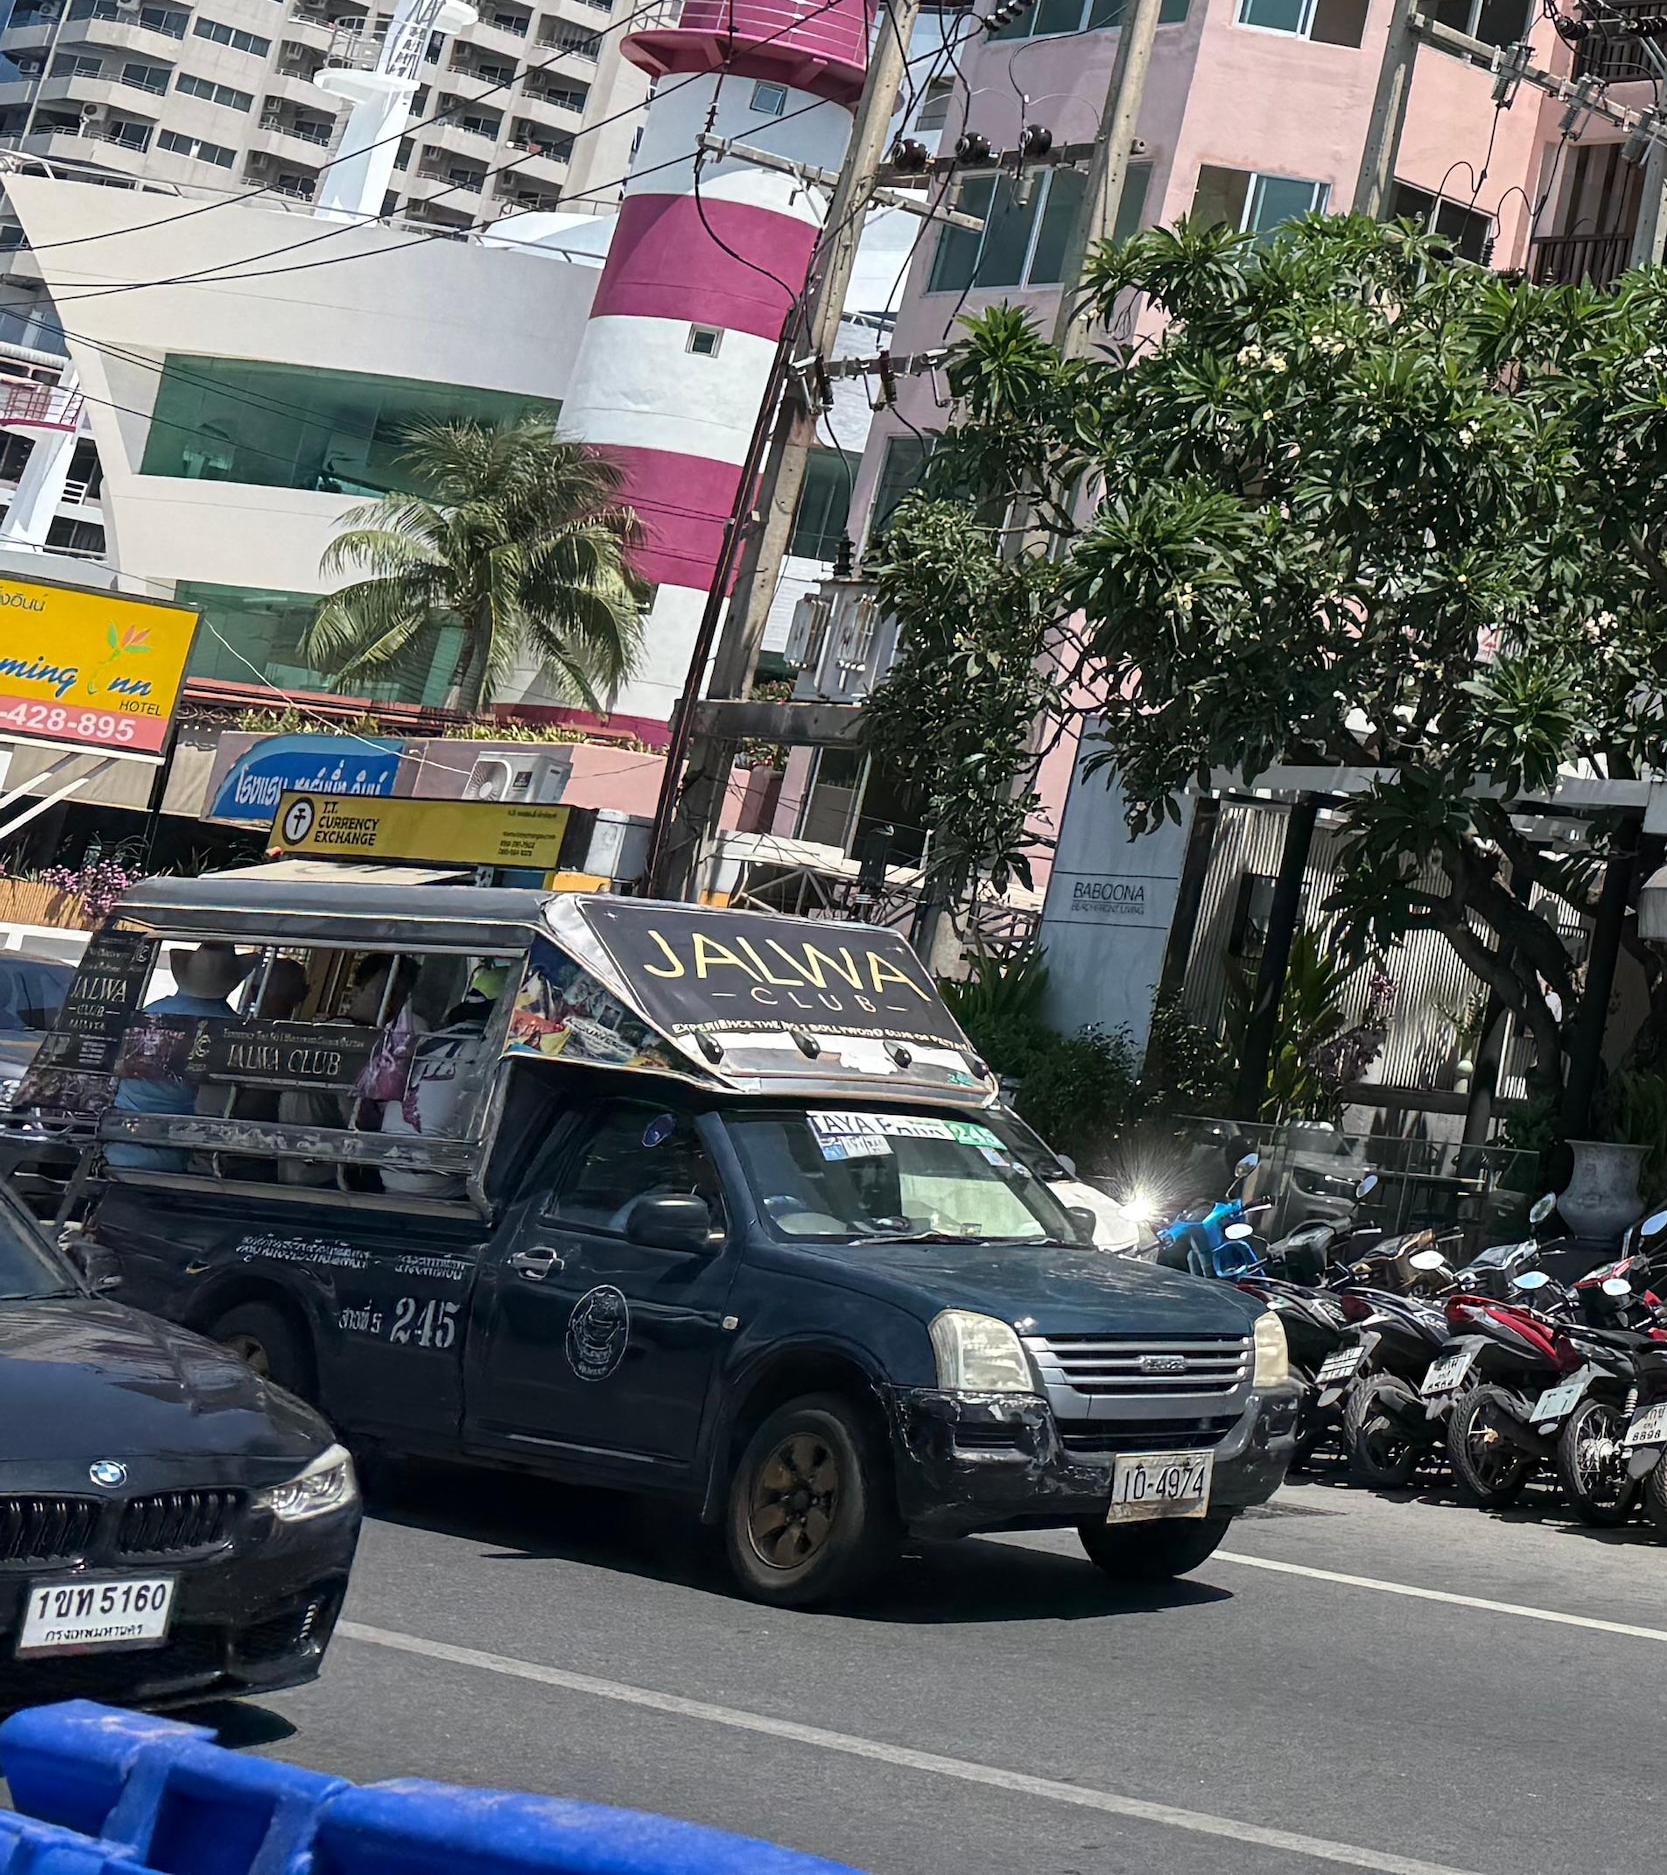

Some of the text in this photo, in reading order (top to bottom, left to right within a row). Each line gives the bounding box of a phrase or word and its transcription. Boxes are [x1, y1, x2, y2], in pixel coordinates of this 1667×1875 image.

[119, 699, 162, 717] HOTEL
[318, 816, 380, 832] CURRENCY
[313, 830, 378, 847] EXCHANGE
[1073, 882, 1145, 901] BABOONA
[643, 929, 932, 1002] JALWA
[750, 986, 878, 1013] CLUB
[287, 1049, 341, 1076] CLUB
[389, 1296, 461, 1349] 245
[1123, 1465, 1206, 1503] 10-4974
[100, 1583, 167, 1615] 5160
